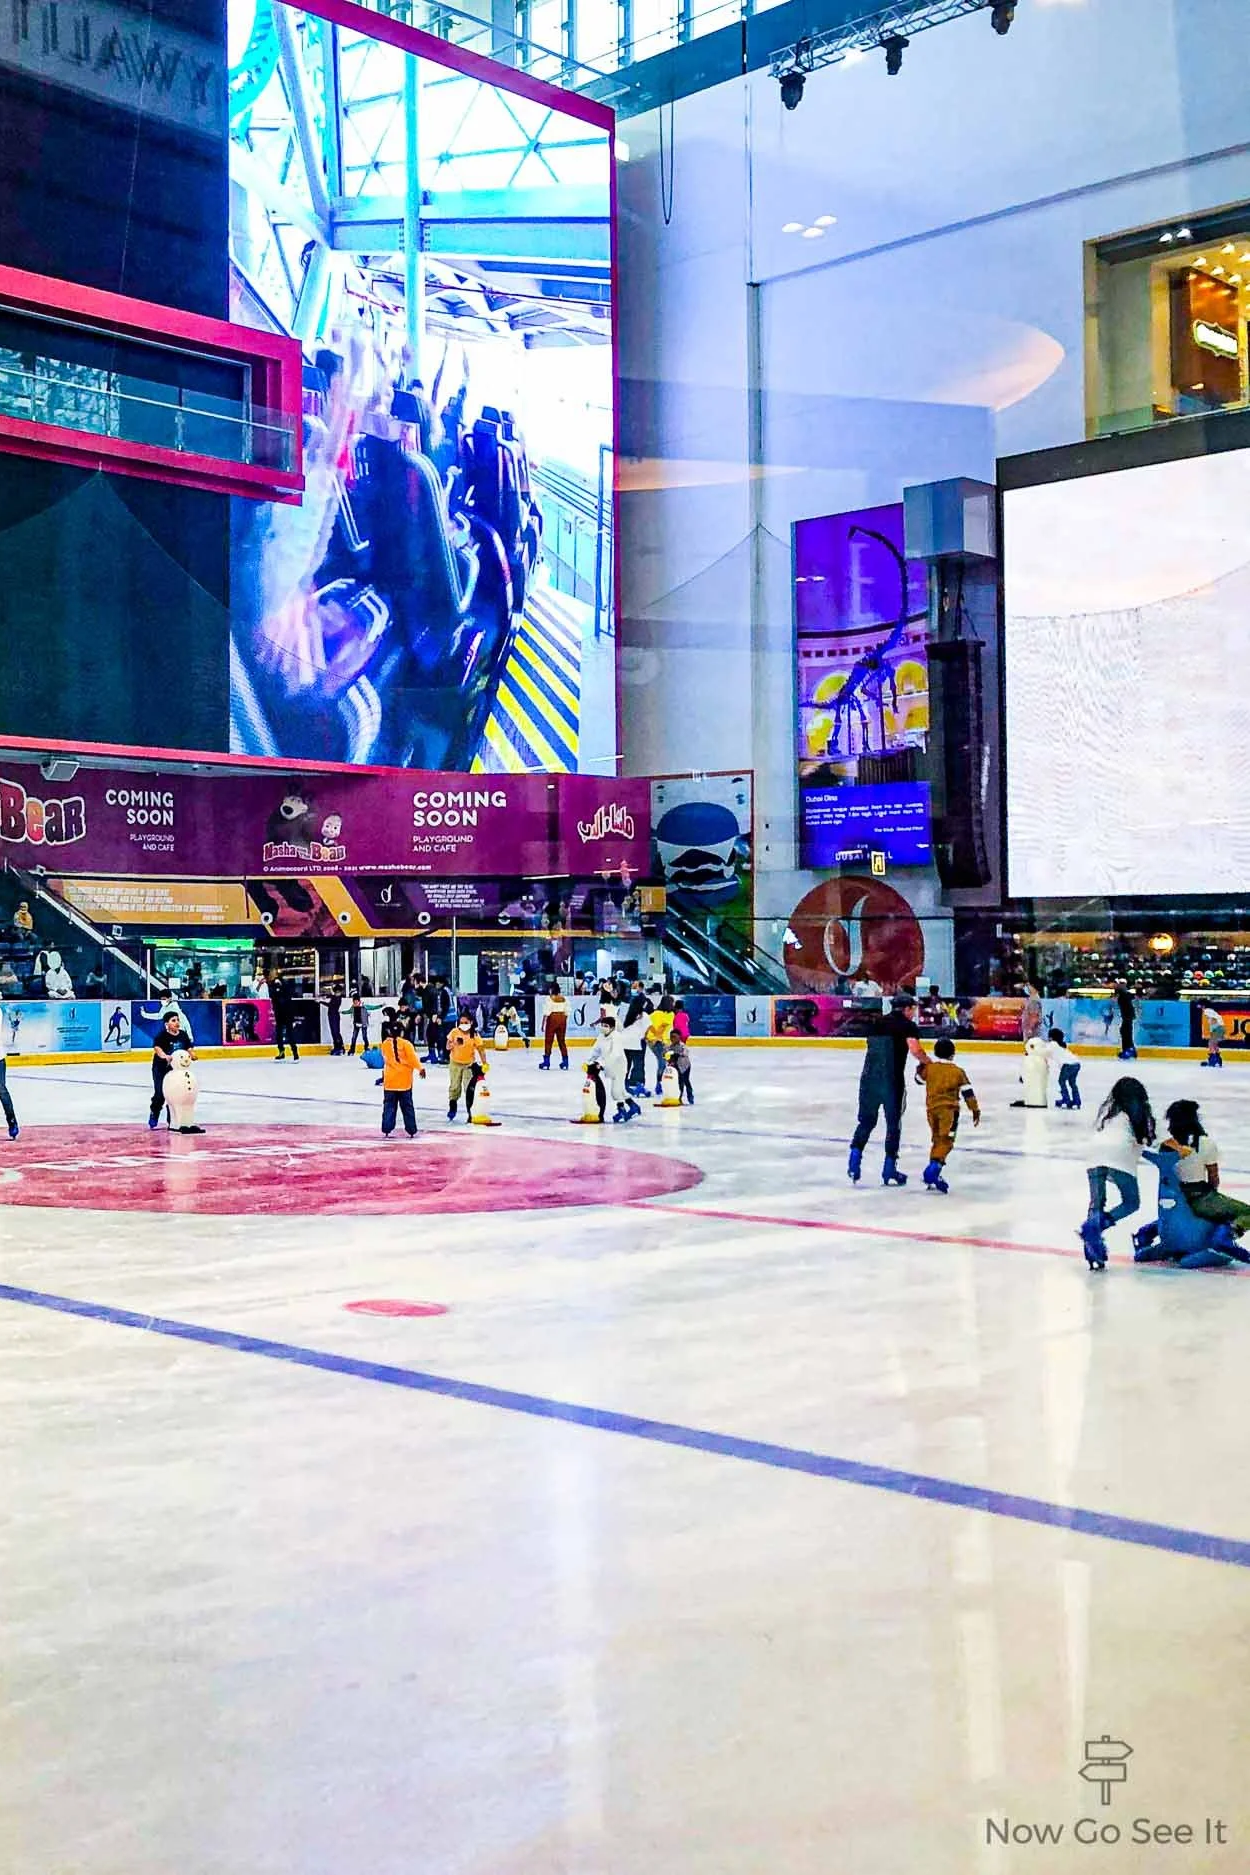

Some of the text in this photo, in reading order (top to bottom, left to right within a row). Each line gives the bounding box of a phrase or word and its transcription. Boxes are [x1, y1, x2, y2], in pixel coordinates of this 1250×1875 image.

[105, 789, 174, 807] COMING
[413, 791, 507, 808] COMING
[126, 808, 174, 826] SOON
[413, 809, 478, 827] SOON
[130, 834, 175, 842] PLAYGROUND
[413, 835, 474, 843] PLAYGROUND
[142, 843, 175, 852] AND CAFE
[433, 844, 457, 853] CAFE
